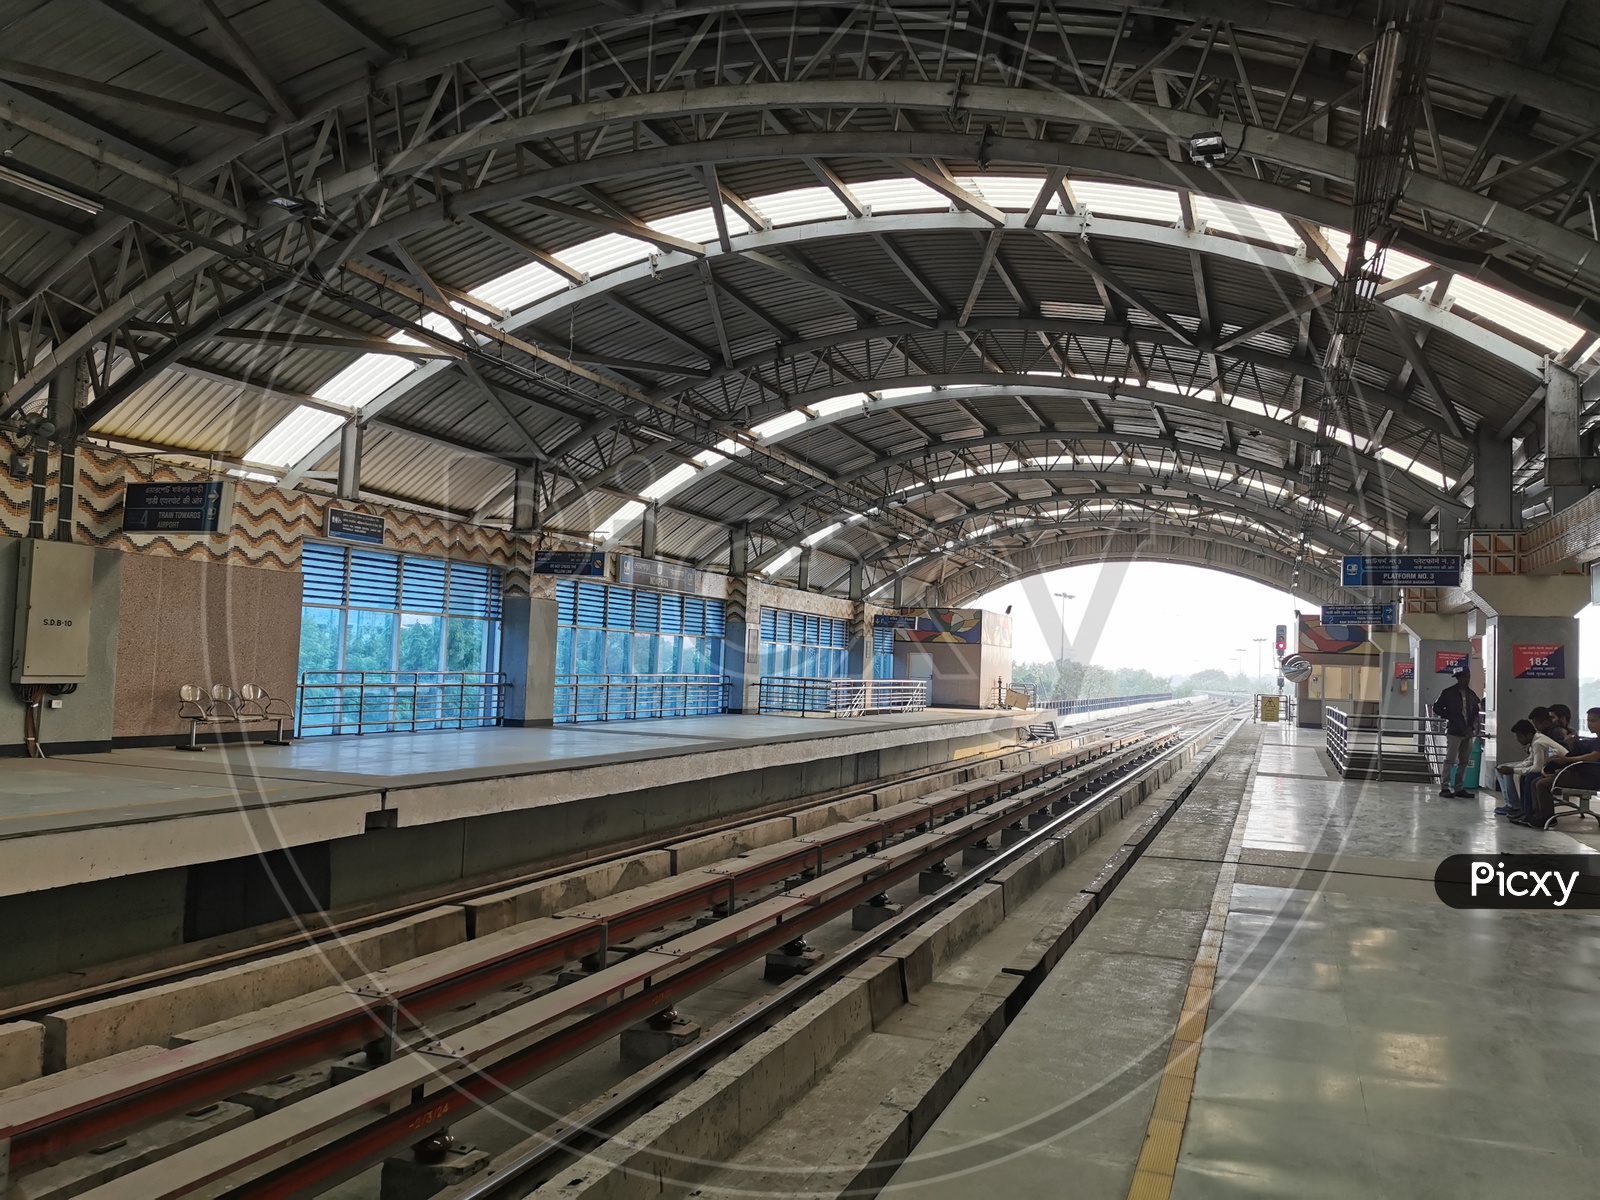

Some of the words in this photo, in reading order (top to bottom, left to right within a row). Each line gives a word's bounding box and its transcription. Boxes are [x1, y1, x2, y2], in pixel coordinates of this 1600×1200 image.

[140, 510, 149, 528] 4
[158, 511, 174, 519] TRAIN
[175, 511, 201, 519] TOWARDS
[157, 521, 180, 529] AIRPORT
[43, 618, 73, 627] S.D.B-10
[1529, 657, 1549, 666] 182
